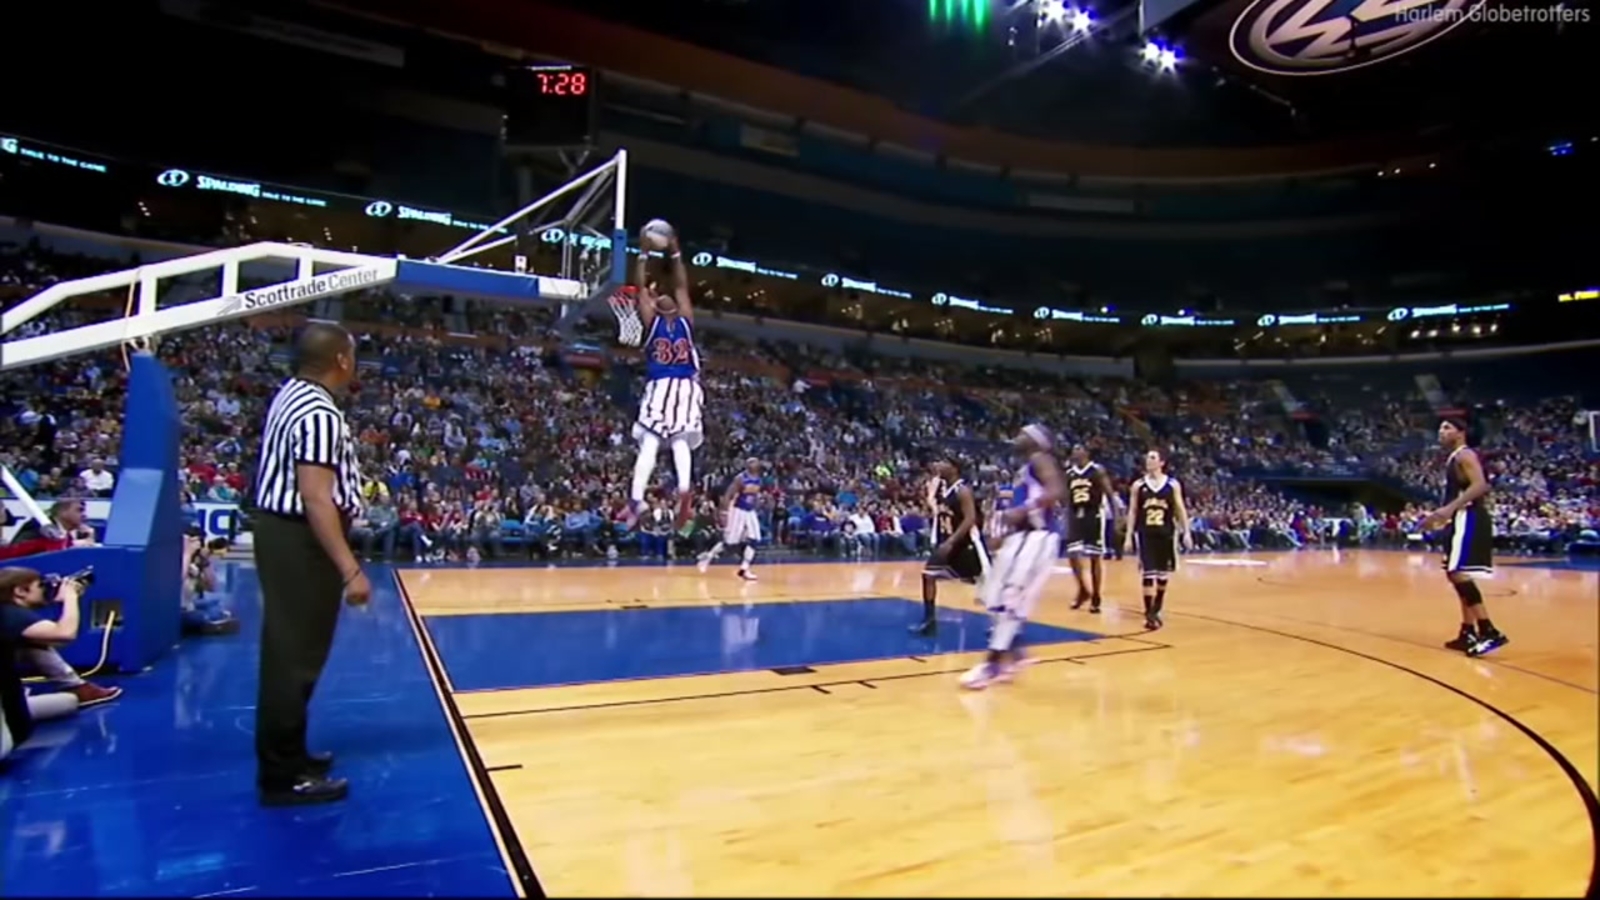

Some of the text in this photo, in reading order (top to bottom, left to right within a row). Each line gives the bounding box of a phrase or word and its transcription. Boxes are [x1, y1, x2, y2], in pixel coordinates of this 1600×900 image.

[537, 73, 585, 95] 7:28
[197, 176, 260, 197] SPALDING
[244, 269, 378, 309] Scottrade Center
[653, 338, 689, 364] 32
[1146, 508, 1164, 526] 22
